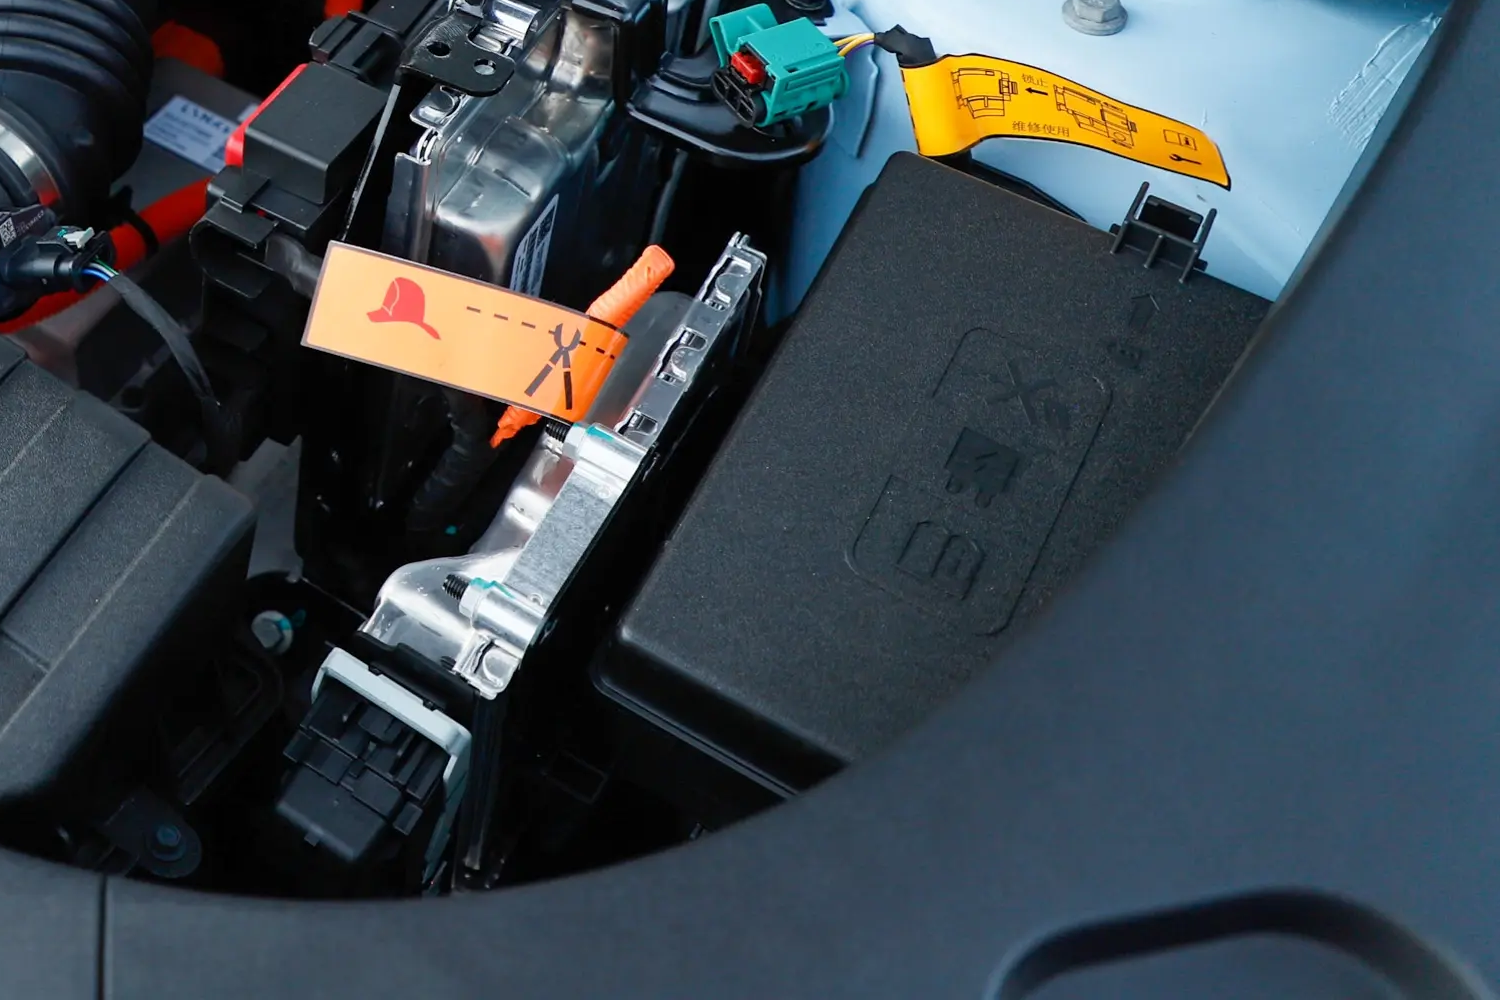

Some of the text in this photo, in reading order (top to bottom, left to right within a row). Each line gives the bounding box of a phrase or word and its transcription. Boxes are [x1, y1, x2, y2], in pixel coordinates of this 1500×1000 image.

[1021, 73, 1049, 88] 锁止
[1012, 120, 1070, 138] 维修使用
